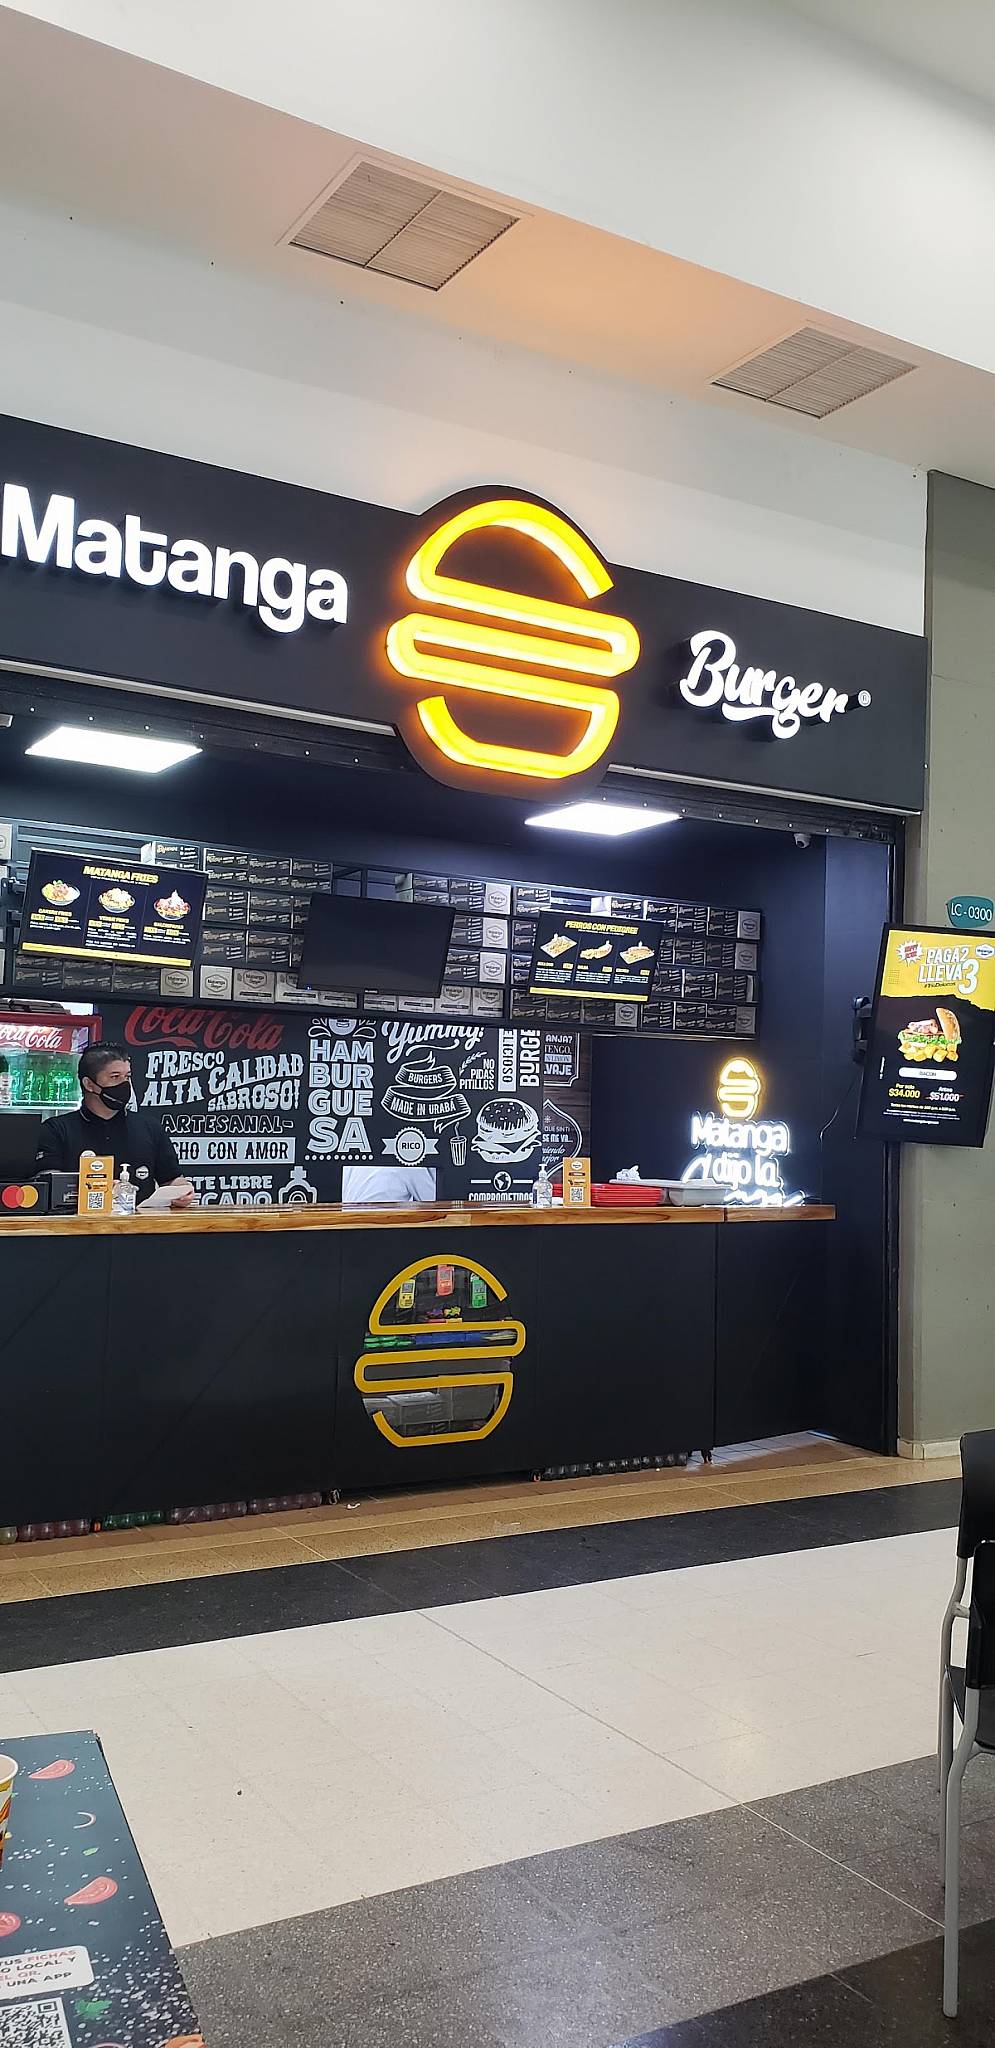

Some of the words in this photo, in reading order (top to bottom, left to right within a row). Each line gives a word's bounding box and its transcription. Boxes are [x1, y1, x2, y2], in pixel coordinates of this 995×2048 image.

[2, 482, 349, 633] Matanga
[679, 630, 849, 739] Burger
[83, 865, 130, 880] MATANGA
[130, 872, 159, 884] FRIES
[926, 947, 960, 964] PAGA
[960, 946, 970, 963] 2
[918, 962, 962, 983] LLEVA
[958, 958, 980, 995] 3
[545, 1034, 573, 1044] ANJA?
[309, 1039, 375, 1063] HAM
[502, 1029, 514, 1083] ELICIOSO
[520, 1029, 541, 1087] BURGE
[145, 1050, 225, 1079] FRESCO
[482, 1058, 495, 1069] NO
[543, 1063, 573, 1076] VAJE
[140, 1076, 205, 1107] ALTA
[208, 1053, 304, 1095] CALIDAD
[308, 1062, 374, 1089] BUR
[408, 1072, 443, 1084] BURGERS
[470, 1068, 495, 1080] PIDAS
[459, 1079, 495, 1090] PITILLOS
[888, 1088, 921, 1099] $34.000
[207, 1079, 301, 1112] SABROSO!
[307, 1088, 373, 1116] GUE
[390, 1096, 414, 1115] MADE
[417, 1103, 426, 1116] IN
[428, 1098, 456, 1115] URABÁ
[306, 1116, 372, 1154] SA
[691, 1111, 789, 1156] Matanga
[172, 1141, 200, 1160] CHO
[207, 1141, 237, 1160] CON
[245, 1141, 289, 1160] AMOR
[401, 1141, 421, 1150] RICO
[185, 1176, 216, 1190] TE
[218, 1175, 273, 1190] LIBRE
[16, 1959, 63, 1971] LOCAL
[27, 1949, 77, 1962] FICHAS
[7, 1978, 38, 1987] UNA
[43, 1972, 72, 1982] APP
